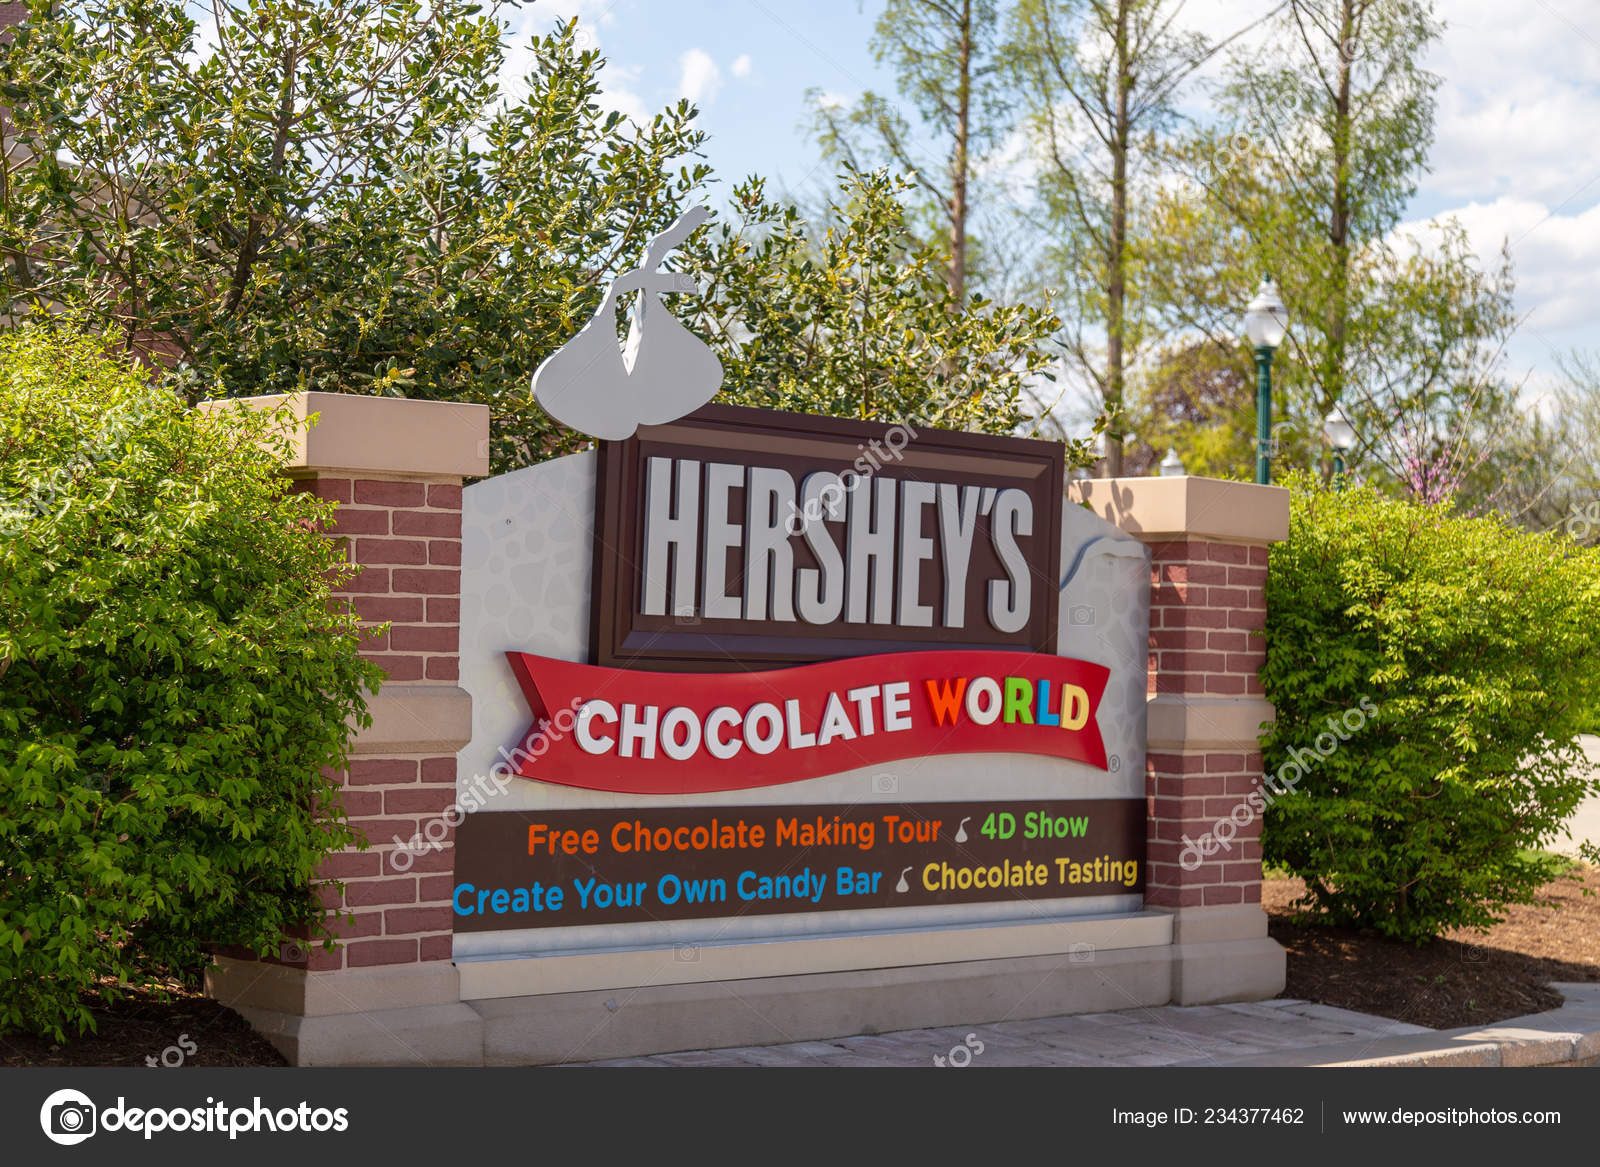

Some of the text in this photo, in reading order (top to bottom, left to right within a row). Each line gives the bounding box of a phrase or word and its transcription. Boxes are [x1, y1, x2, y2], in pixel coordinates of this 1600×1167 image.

[641, 456, 1033, 633] HERSHEY'S
[574, 681, 912, 760] CHOCOLATE
[925, 676, 1090, 731] WORLD
[528, 810, 1089, 855] Free Chocolate Making Tour 4D Show
[452, 855, 1138, 916] Create Your Own Candy Bar Chocolate Tasting
